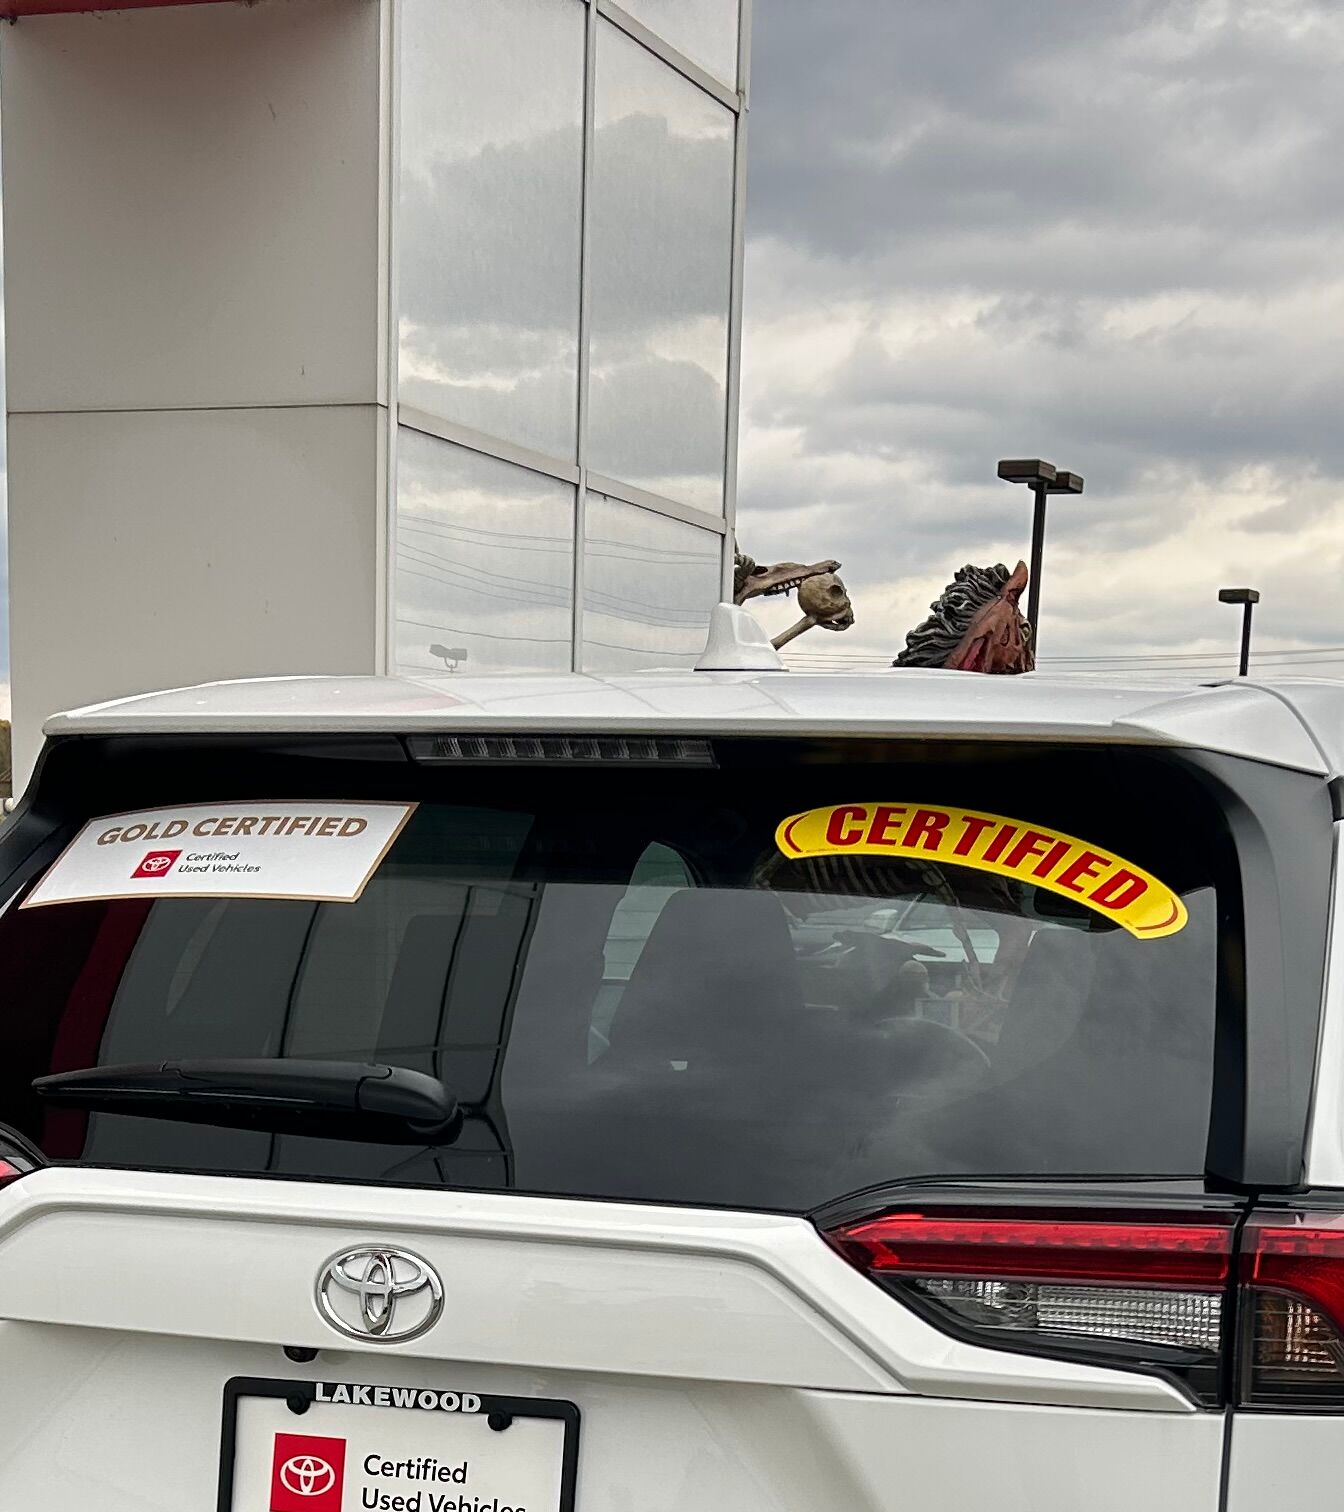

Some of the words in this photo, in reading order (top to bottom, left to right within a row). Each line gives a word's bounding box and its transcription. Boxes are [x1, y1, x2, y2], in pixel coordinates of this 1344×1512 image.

[97, 819, 188, 846] GOLD
[192, 816, 368, 837] CERTIFIED
[178, 864, 208, 873] Used
[211, 863, 262, 873] Vehicles
[186, 851, 240, 862] Certified
[826, 806, 1149, 910] CERTIFIED
[315, 1382, 482, 1414] LAKEWOOD
[363, 1454, 468, 1485] Certified
